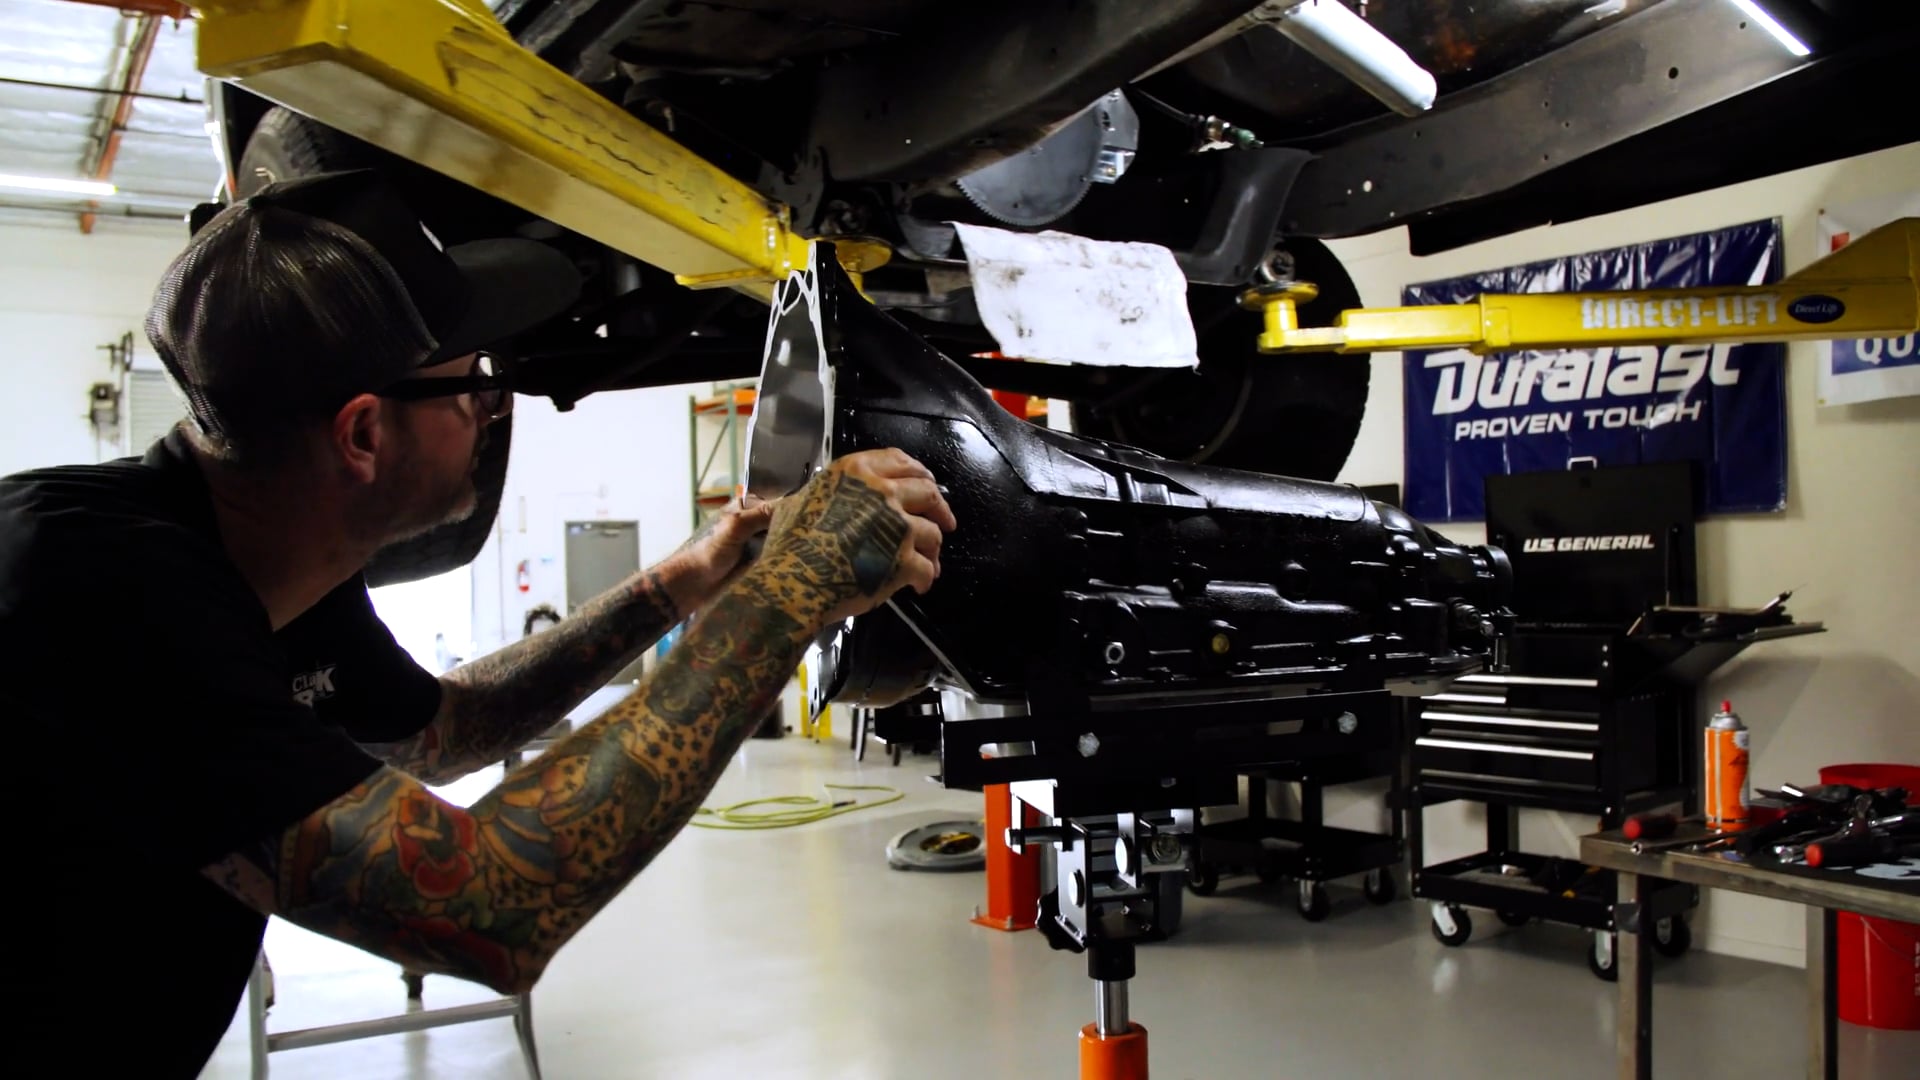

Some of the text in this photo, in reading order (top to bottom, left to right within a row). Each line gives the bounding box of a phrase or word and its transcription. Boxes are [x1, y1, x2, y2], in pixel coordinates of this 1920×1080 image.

[1581, 294, 1781, 330] DIRECT-LIFT
[1855, 331, 1920, 365] QU
[1423, 343, 1744, 416] Duralast
[1454, 400, 1702, 441] PROVEN TOUGH
[1556, 534, 1656, 552] GENERAL
